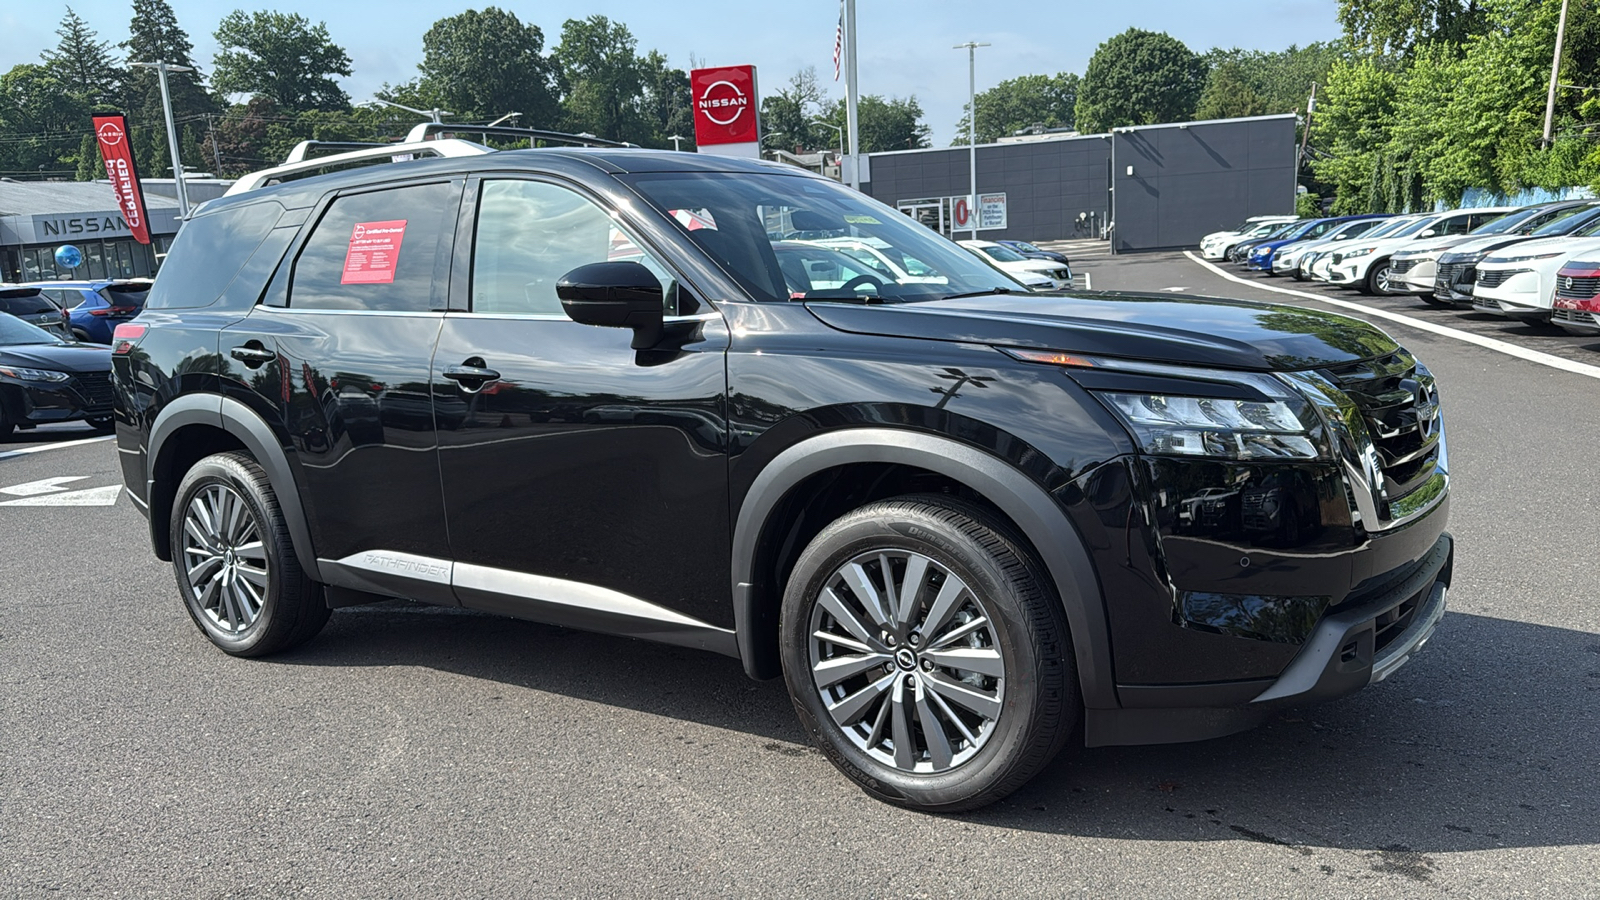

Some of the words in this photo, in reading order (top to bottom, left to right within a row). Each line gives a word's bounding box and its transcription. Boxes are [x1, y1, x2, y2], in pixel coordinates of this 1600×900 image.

[699, 97, 747, 108] NISSAN
[44, 217, 130, 236] NISSAN
[363, 554, 449, 578] PATHFINDER
